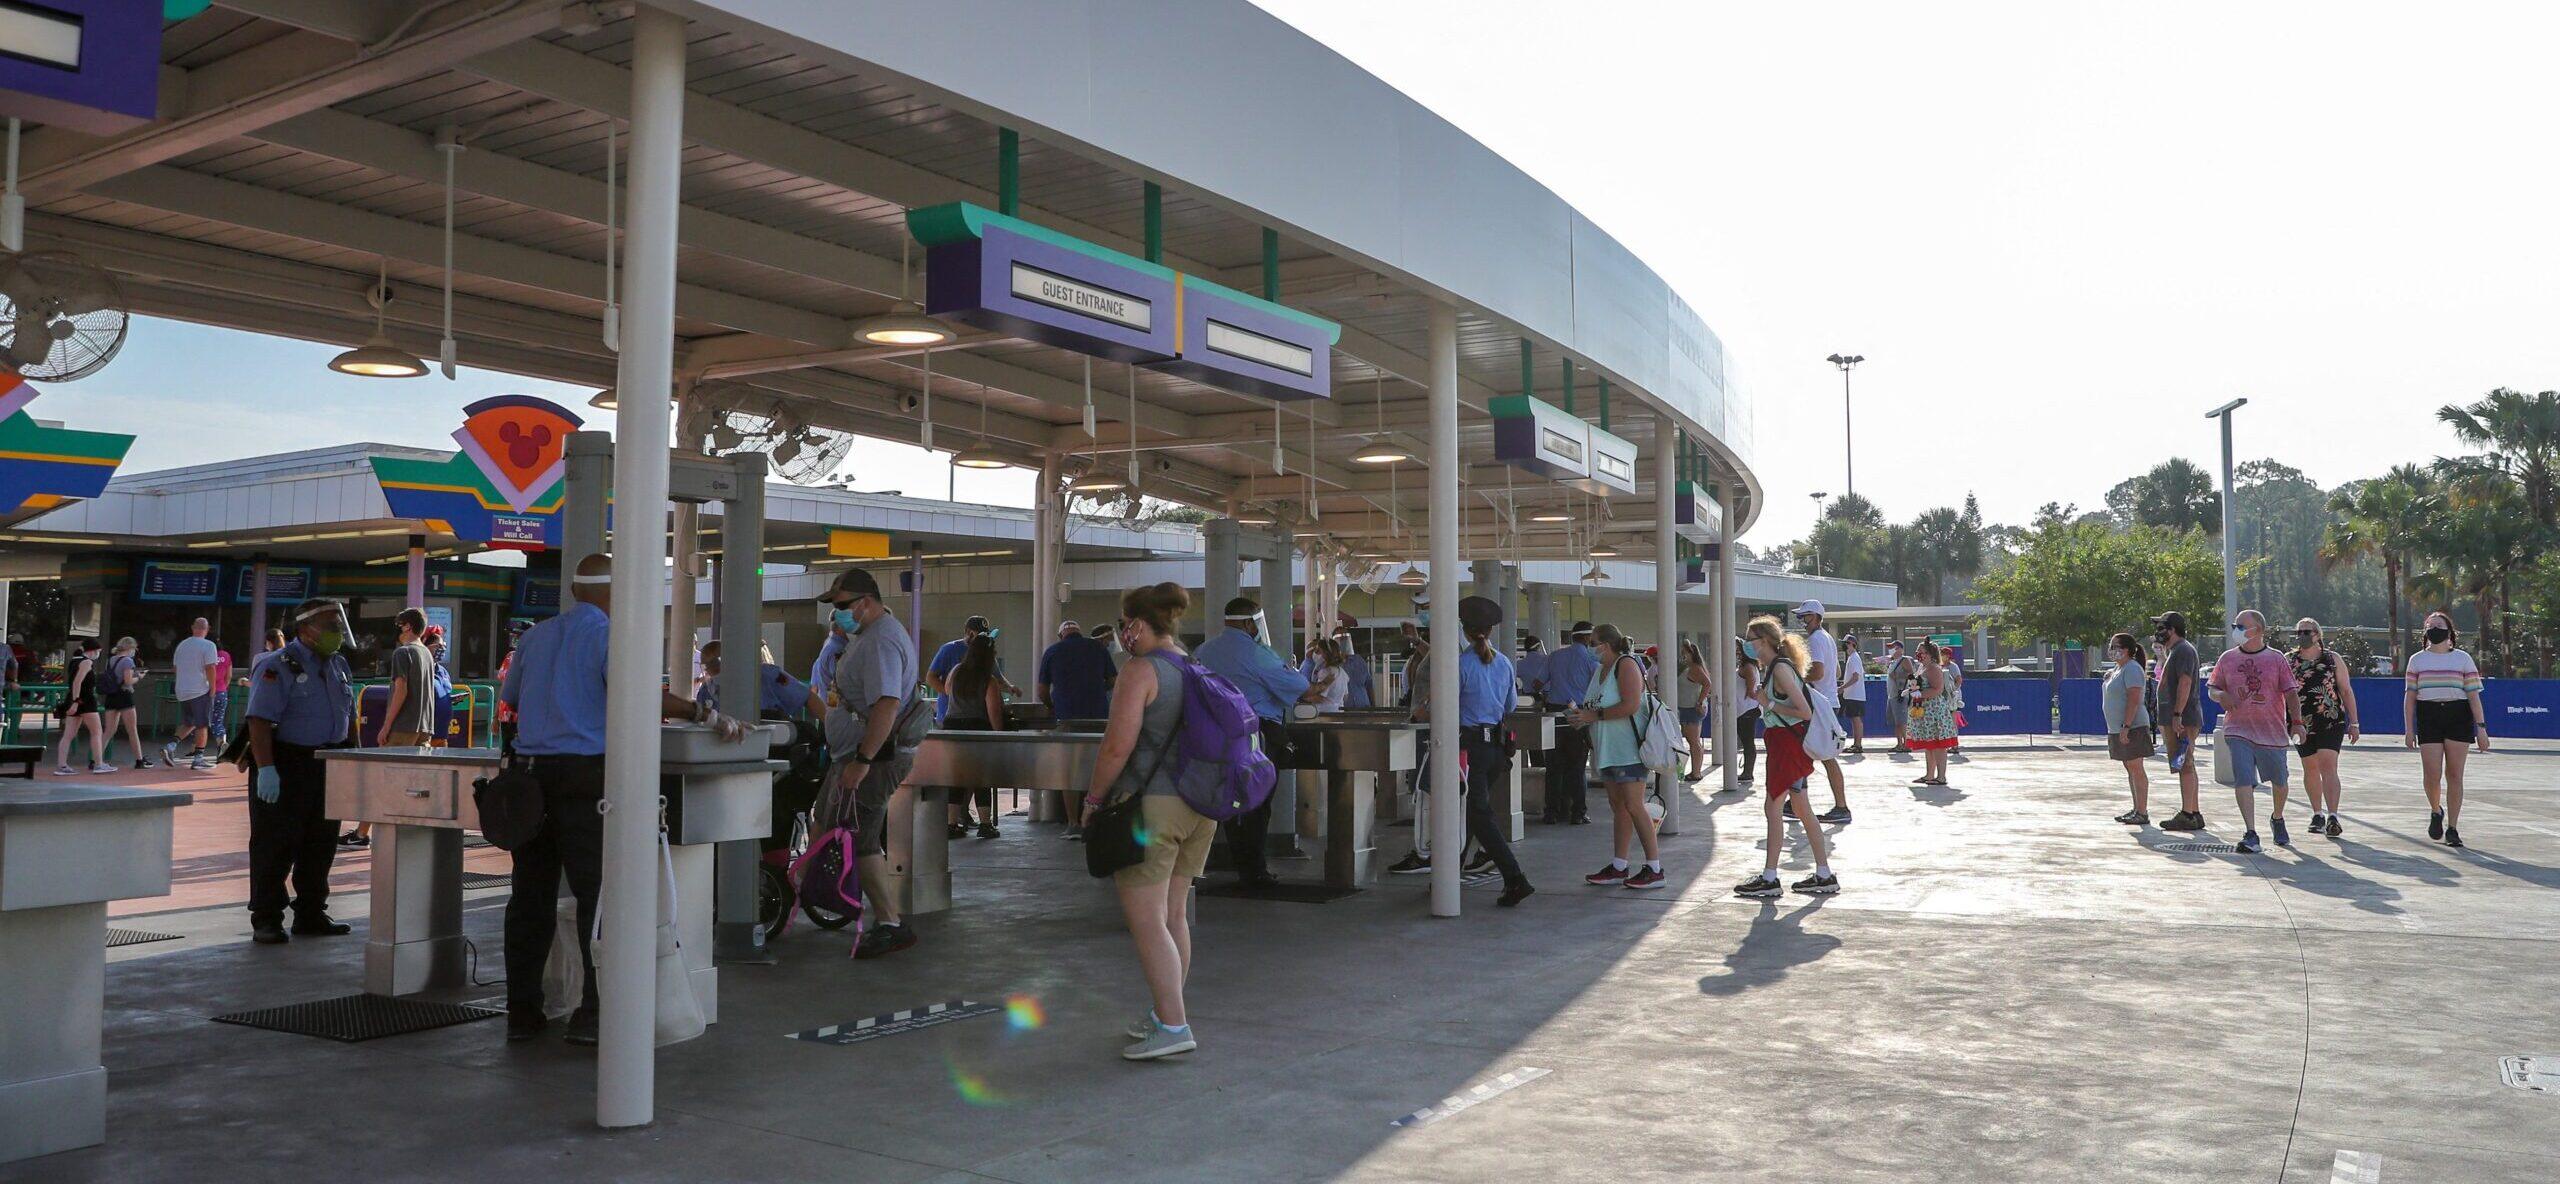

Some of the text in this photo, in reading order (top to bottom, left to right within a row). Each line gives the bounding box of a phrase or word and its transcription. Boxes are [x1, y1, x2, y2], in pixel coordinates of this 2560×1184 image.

[1042, 281, 1125, 317] GUEST ENTRANCE
[497, 518, 520, 526] Ticket
[503, 531, 517, 539] Will
[432, 574, 439, 590] 1
